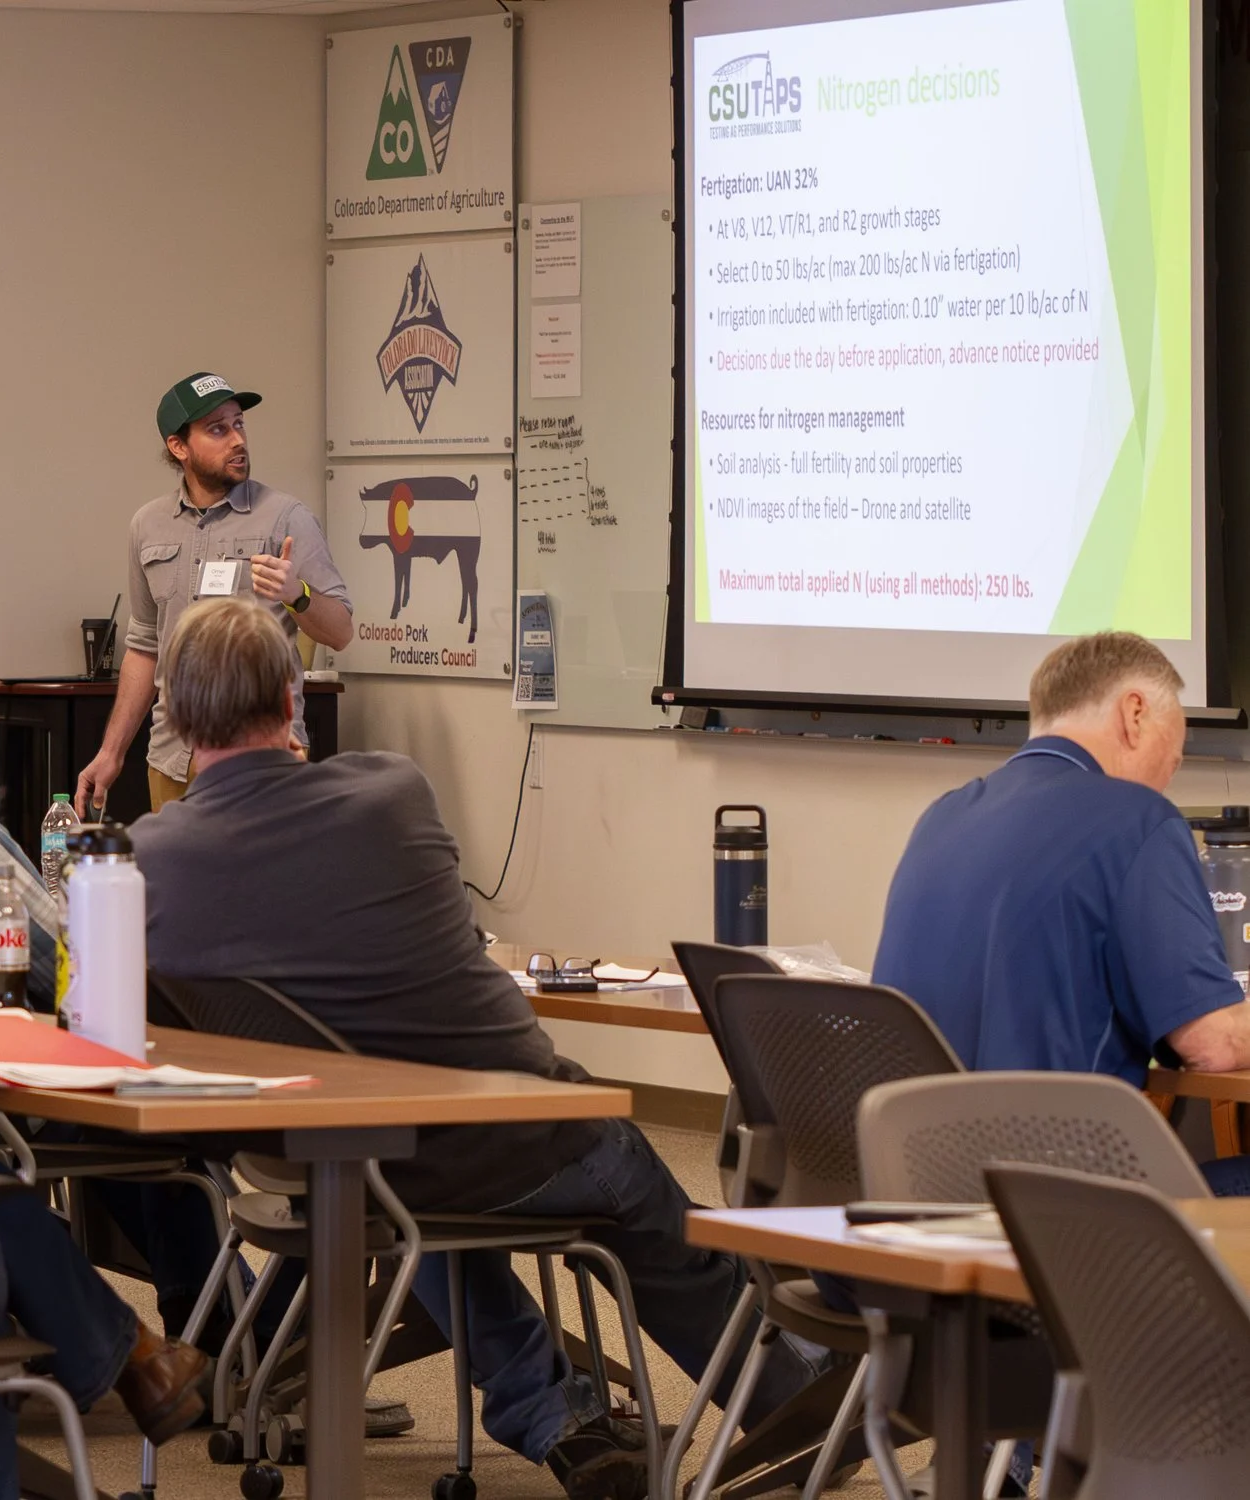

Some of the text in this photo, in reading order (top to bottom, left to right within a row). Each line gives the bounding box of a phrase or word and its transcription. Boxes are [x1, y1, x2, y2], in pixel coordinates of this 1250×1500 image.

[426, 46, 455, 68] CDA
[817, 62, 999, 117] Nitrogen decisions
[379, 119, 414, 165] CO
[709, 125, 729, 140] TESTING
[738, 121, 774, 138] PERFORMANCE
[774, 118, 801, 135] SOLUTIONS
[701, 167, 818, 200] Fertigation: UAN 32%
[334, 188, 505, 218] Colorado Department of Agriculture
[717, 205, 941, 241] At V8, V12, VT/R1, and R2 growth stages
[717, 244, 1021, 284] Select 0 to 50 lbs/ac (max 200 lbs/ac N via fertigation)
[717, 305, 766, 331] Irrigation
[768, 300, 815, 325] included
[818, 299, 843, 323] with
[846, 297, 909, 326] fertigation:
[947, 296, 982, 318] water
[985, 298, 1005, 321] per
[1009, 292, 1024, 316] 10
[1028, 289, 1058, 318] lb/ac
[1062, 288, 1075, 313] of
[1079, 290, 1088, 312] N
[419, 327, 457, 373] LIVESTOCK
[717, 336, 1099, 372] Decisions due the day before application, advance notice provided
[520, 416, 539, 432] Please
[558, 415, 574, 428] room
[701, 407, 905, 433] Resources for nitrogen management
[717, 451, 736, 475] Soil
[739, 452, 781, 479] analysis
[791, 451, 808, 474] full
[811, 451, 851, 478] fertility
[855, 450, 876, 474] and
[879, 450, 899, 474] soil
[902, 450, 963, 479] properties
[717, 497, 744, 519] NDVI
[747, 497, 785, 523] images
[788, 496, 800, 519] of
[802, 496, 820, 519] the
[824, 496, 848, 519] field
[862, 497, 896, 520] Drone
[900, 496, 921, 520] and
[925, 496, 971, 520] satellite
[719, 568, 1034, 602] Maximum total applied N (using all methods): 250 lbs.
[359, 622, 428, 643] Colorado Pork
[390, 646, 477, 668] Producers Council
